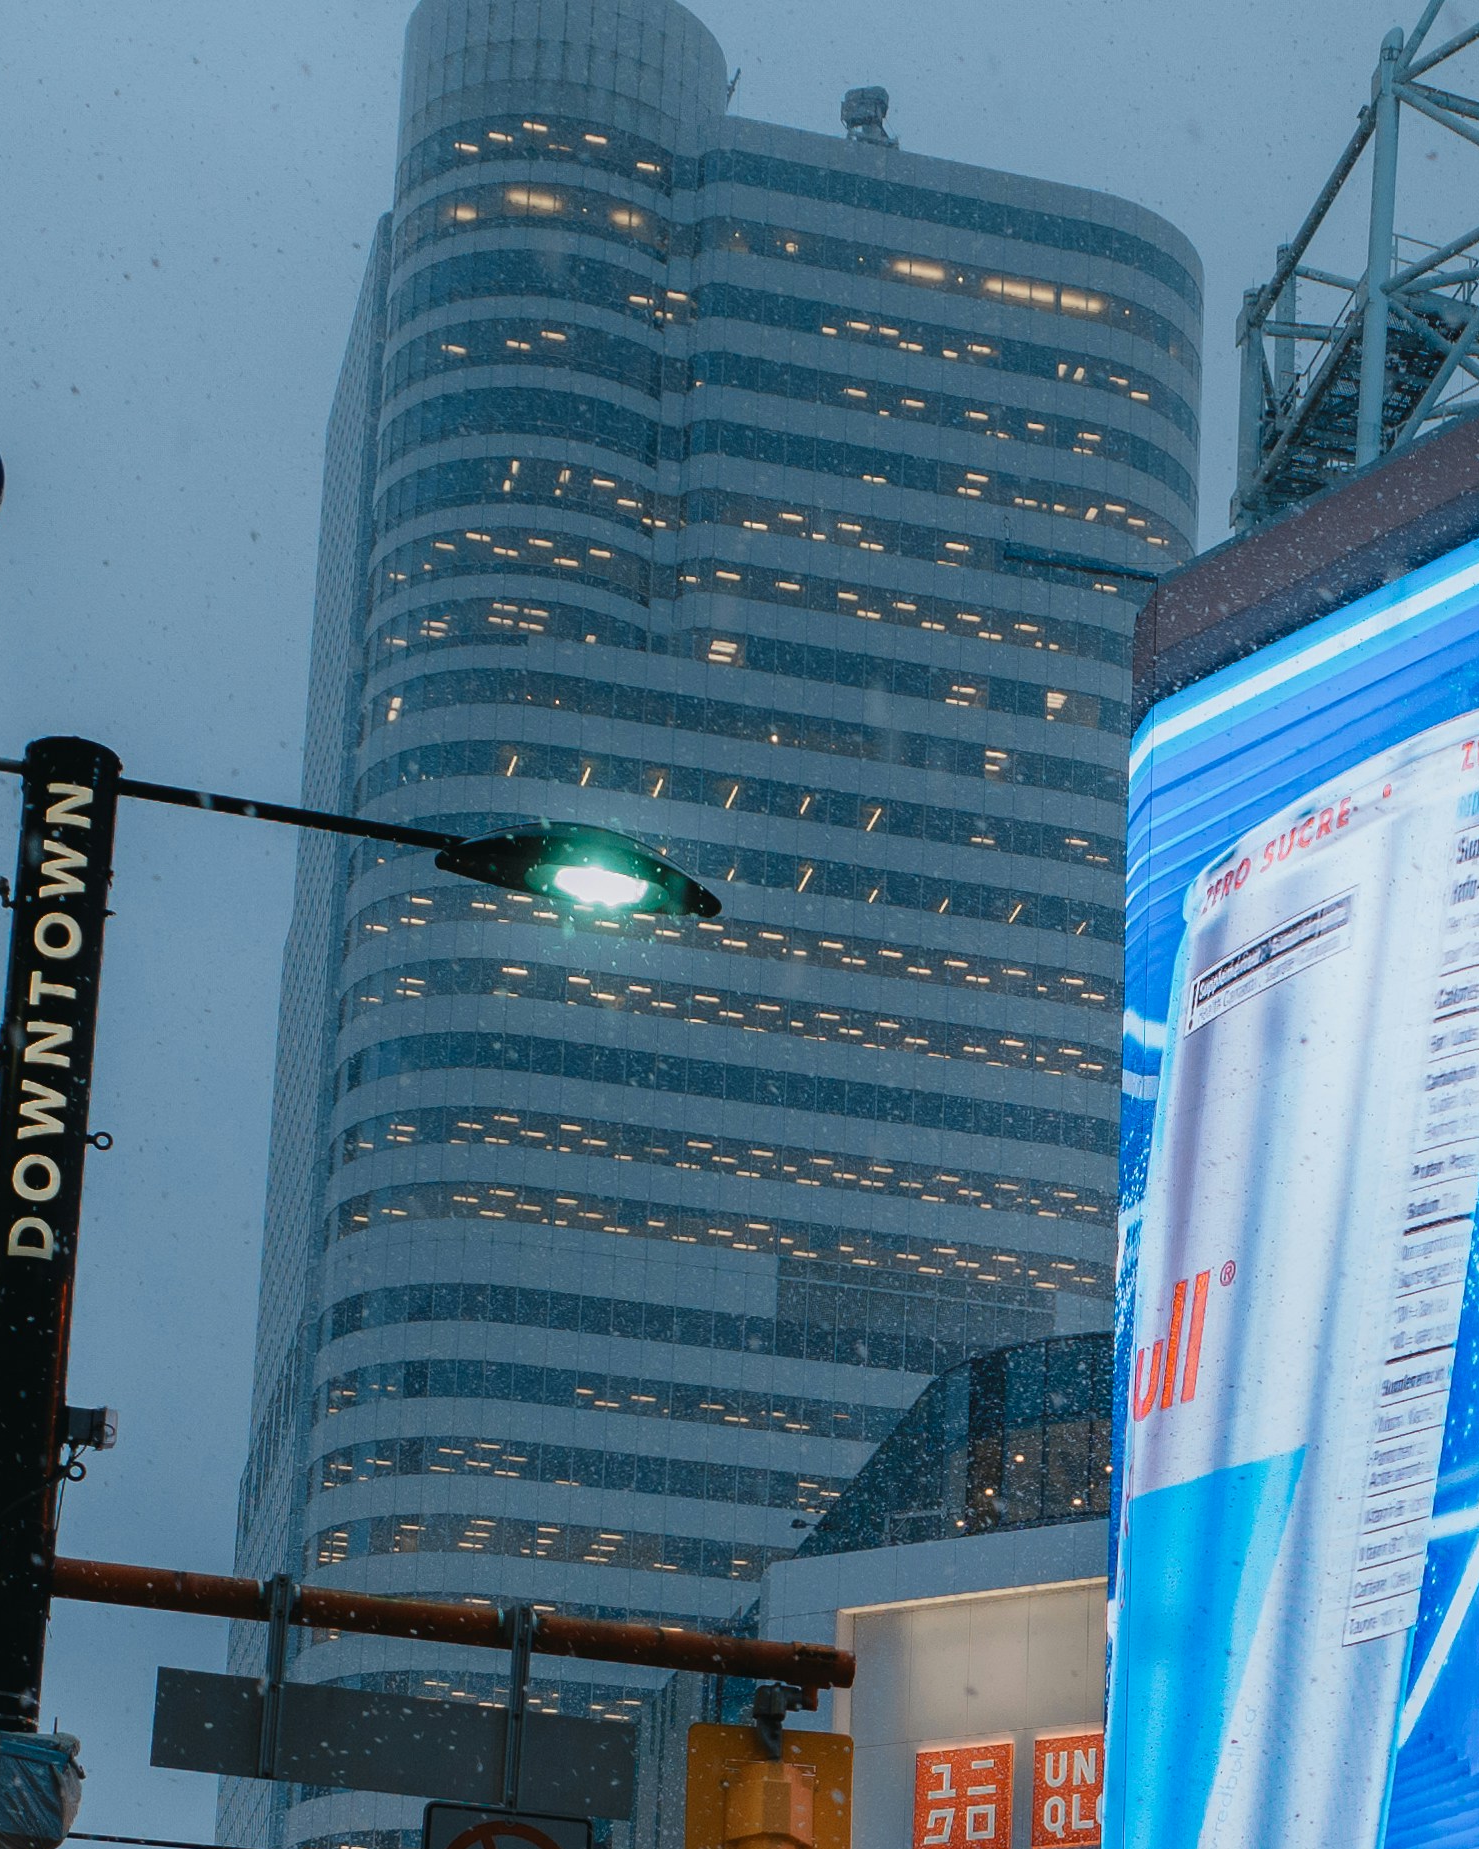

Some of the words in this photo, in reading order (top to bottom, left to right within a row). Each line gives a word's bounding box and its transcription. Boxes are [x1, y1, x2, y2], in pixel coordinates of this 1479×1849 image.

[1200, 856, 1251, 915] ZERO
[1260, 797, 1352, 874] SUCRE
[7, 780, 96, 1262] DOWNTOWN
[1044, 1794, 1102, 1840] QL
